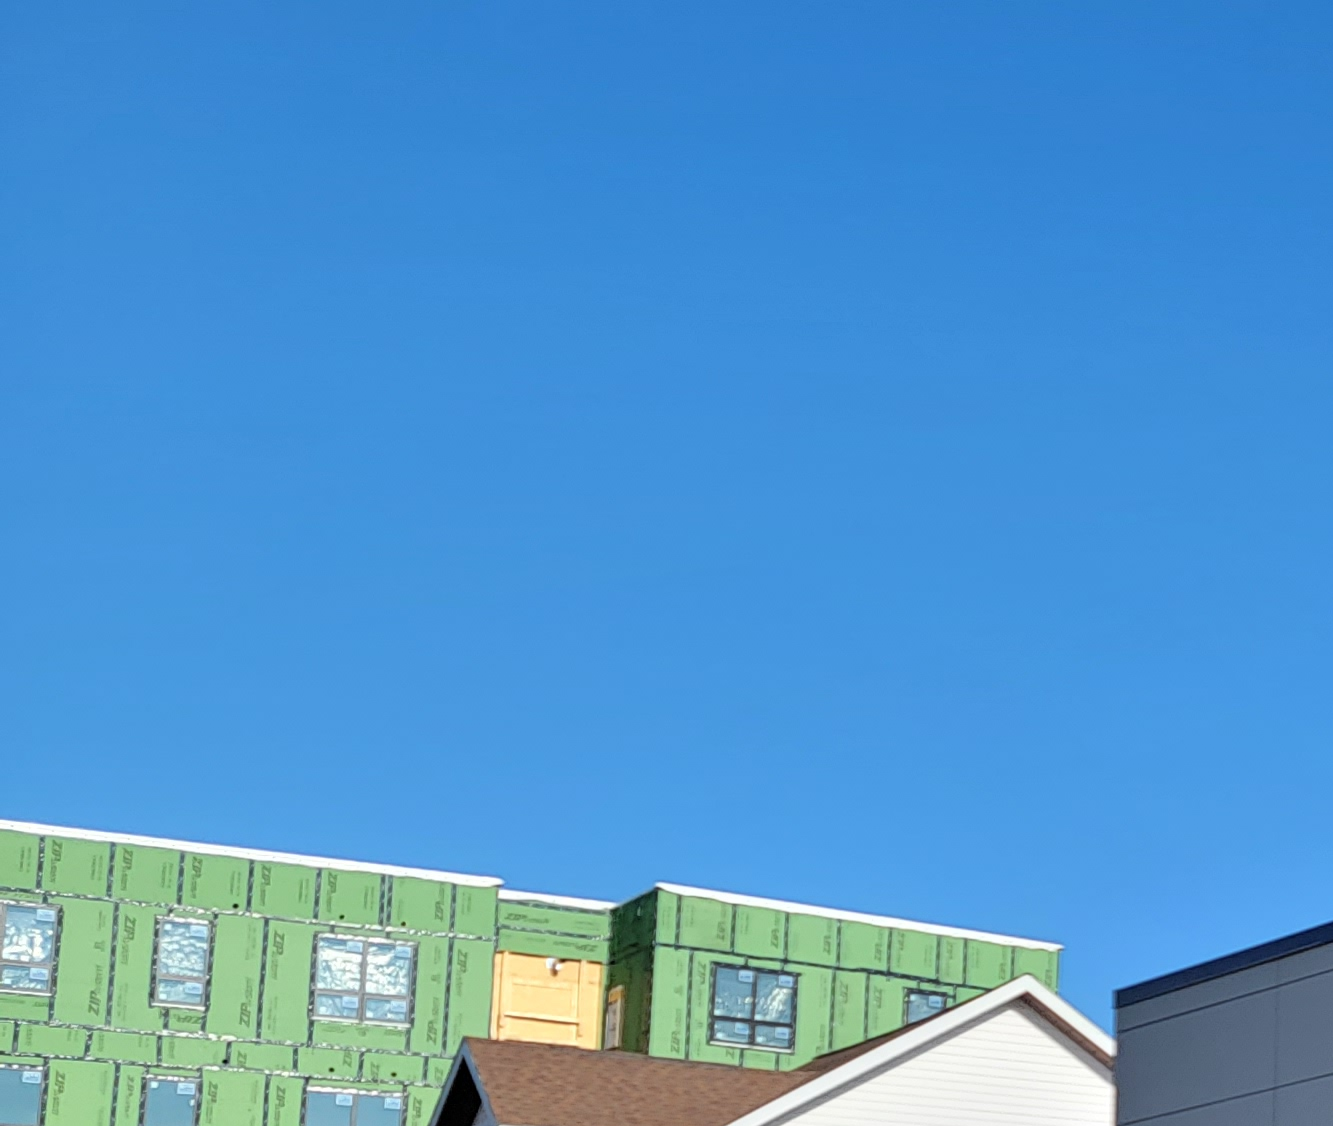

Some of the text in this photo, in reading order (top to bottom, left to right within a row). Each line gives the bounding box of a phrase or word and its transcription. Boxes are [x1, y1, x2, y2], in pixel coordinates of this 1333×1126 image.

[273, 930, 285, 955] ZIP
[88, 990, 102, 1016] ZIP
[239, 1003, 251, 1028] ZIP
